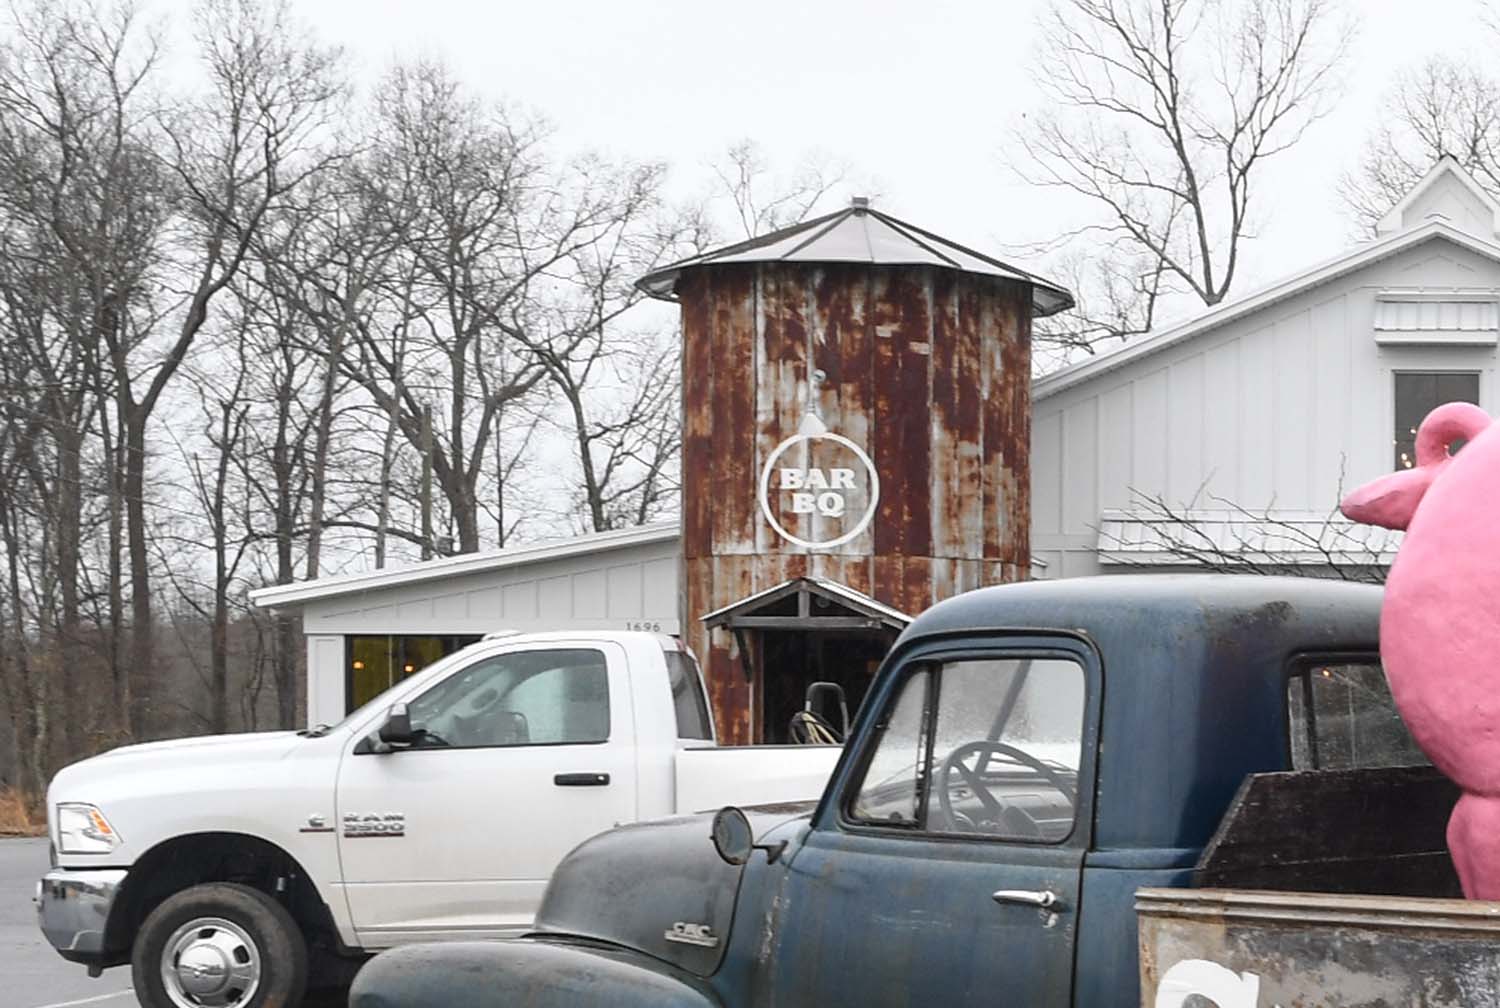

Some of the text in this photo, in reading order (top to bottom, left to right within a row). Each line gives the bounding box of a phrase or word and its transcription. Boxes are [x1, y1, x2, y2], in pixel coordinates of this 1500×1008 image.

[779, 468, 857, 490] BAR
[791, 492, 845, 518] BQ
[343, 812, 404, 822] RAM
